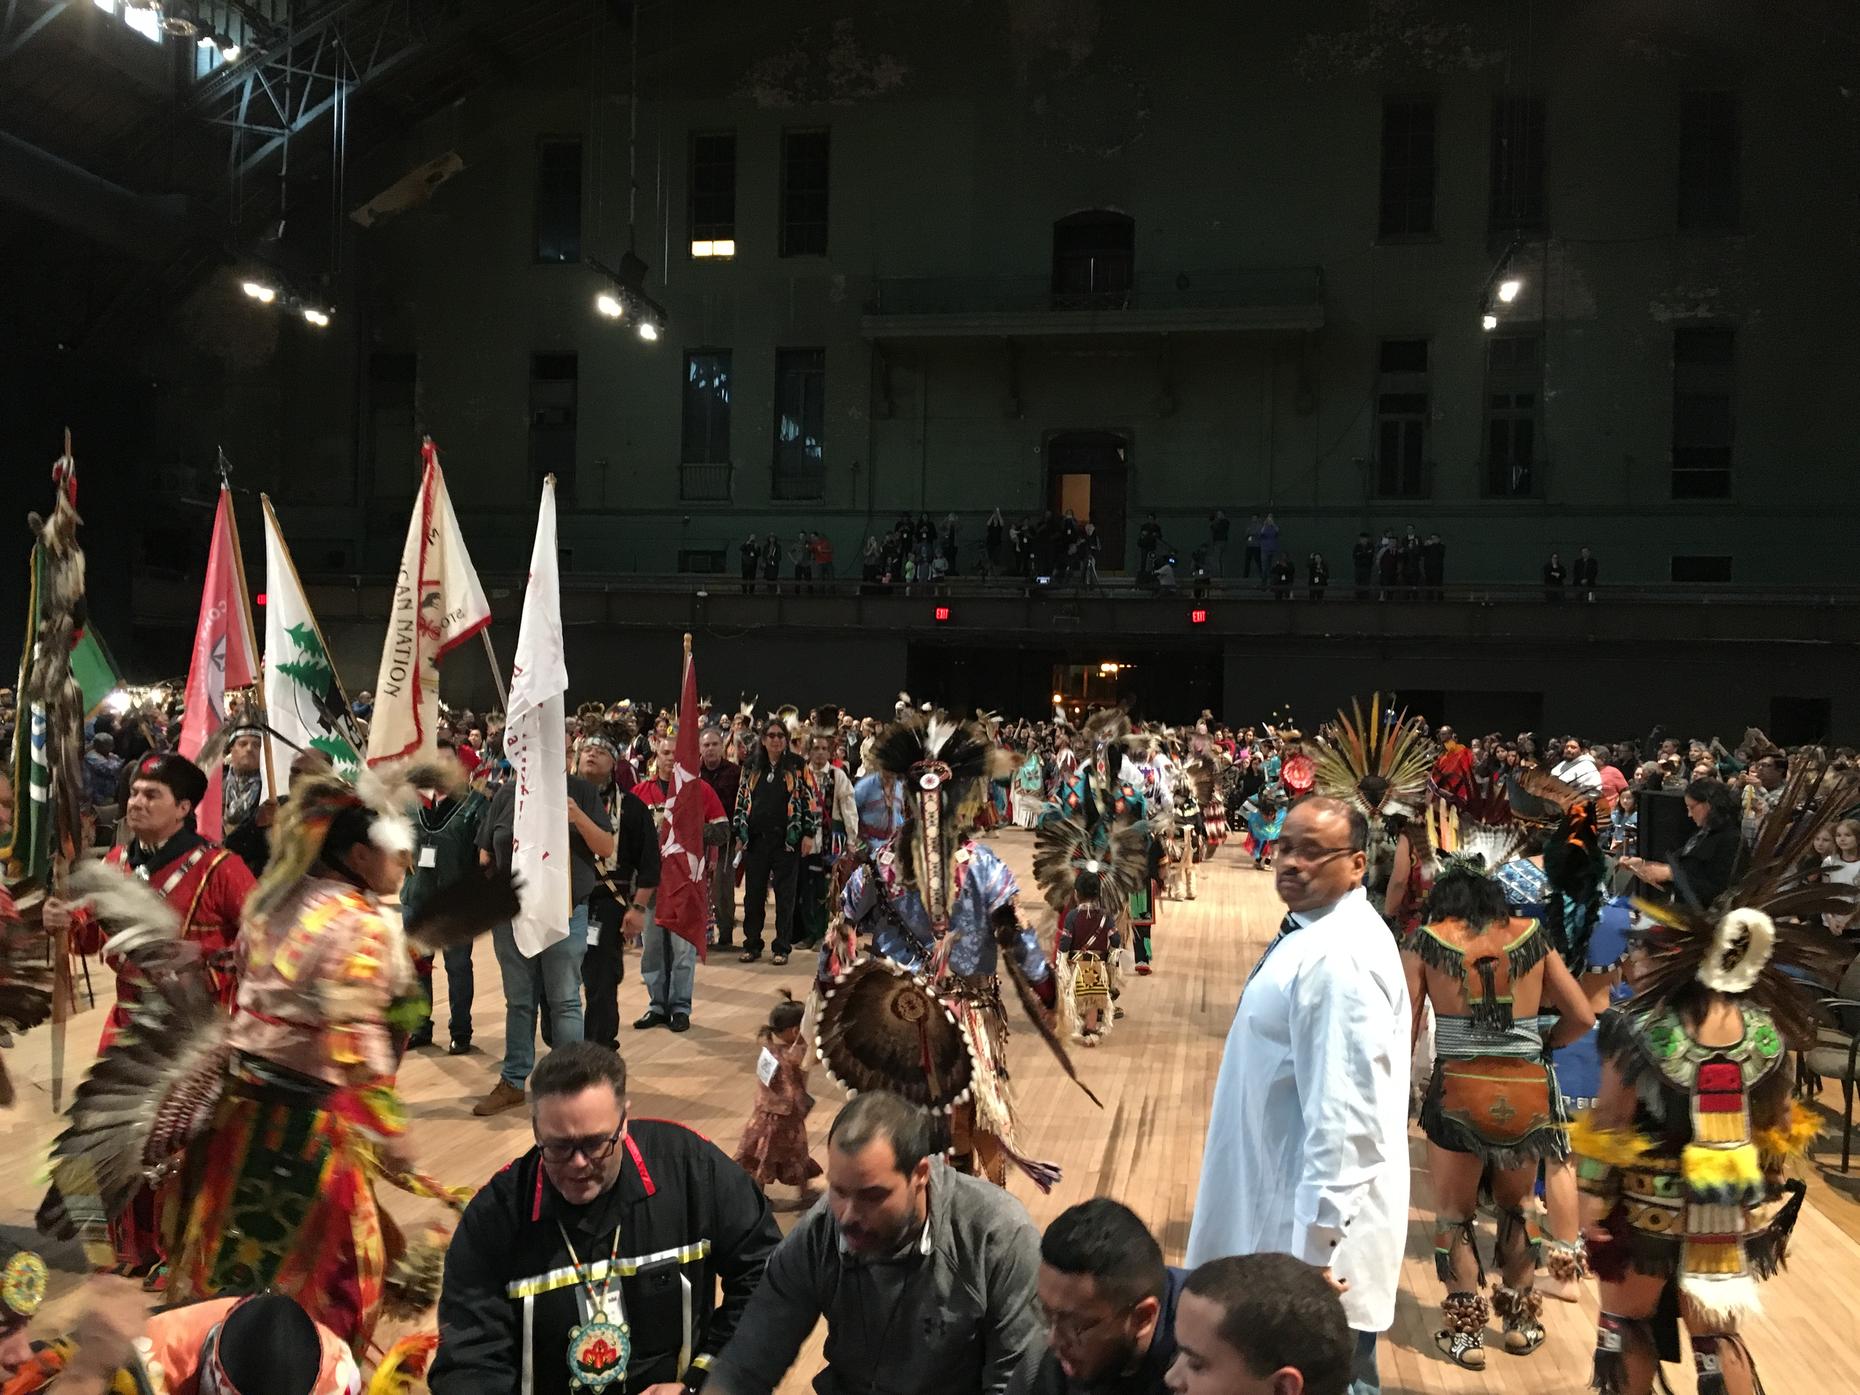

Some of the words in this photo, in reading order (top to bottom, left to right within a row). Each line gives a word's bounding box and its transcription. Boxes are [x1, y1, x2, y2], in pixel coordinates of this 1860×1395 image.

[936, 608, 949, 620] EXIT
[1192, 610, 1206, 622] EXIT
[384, 620, 413, 697] NATION
